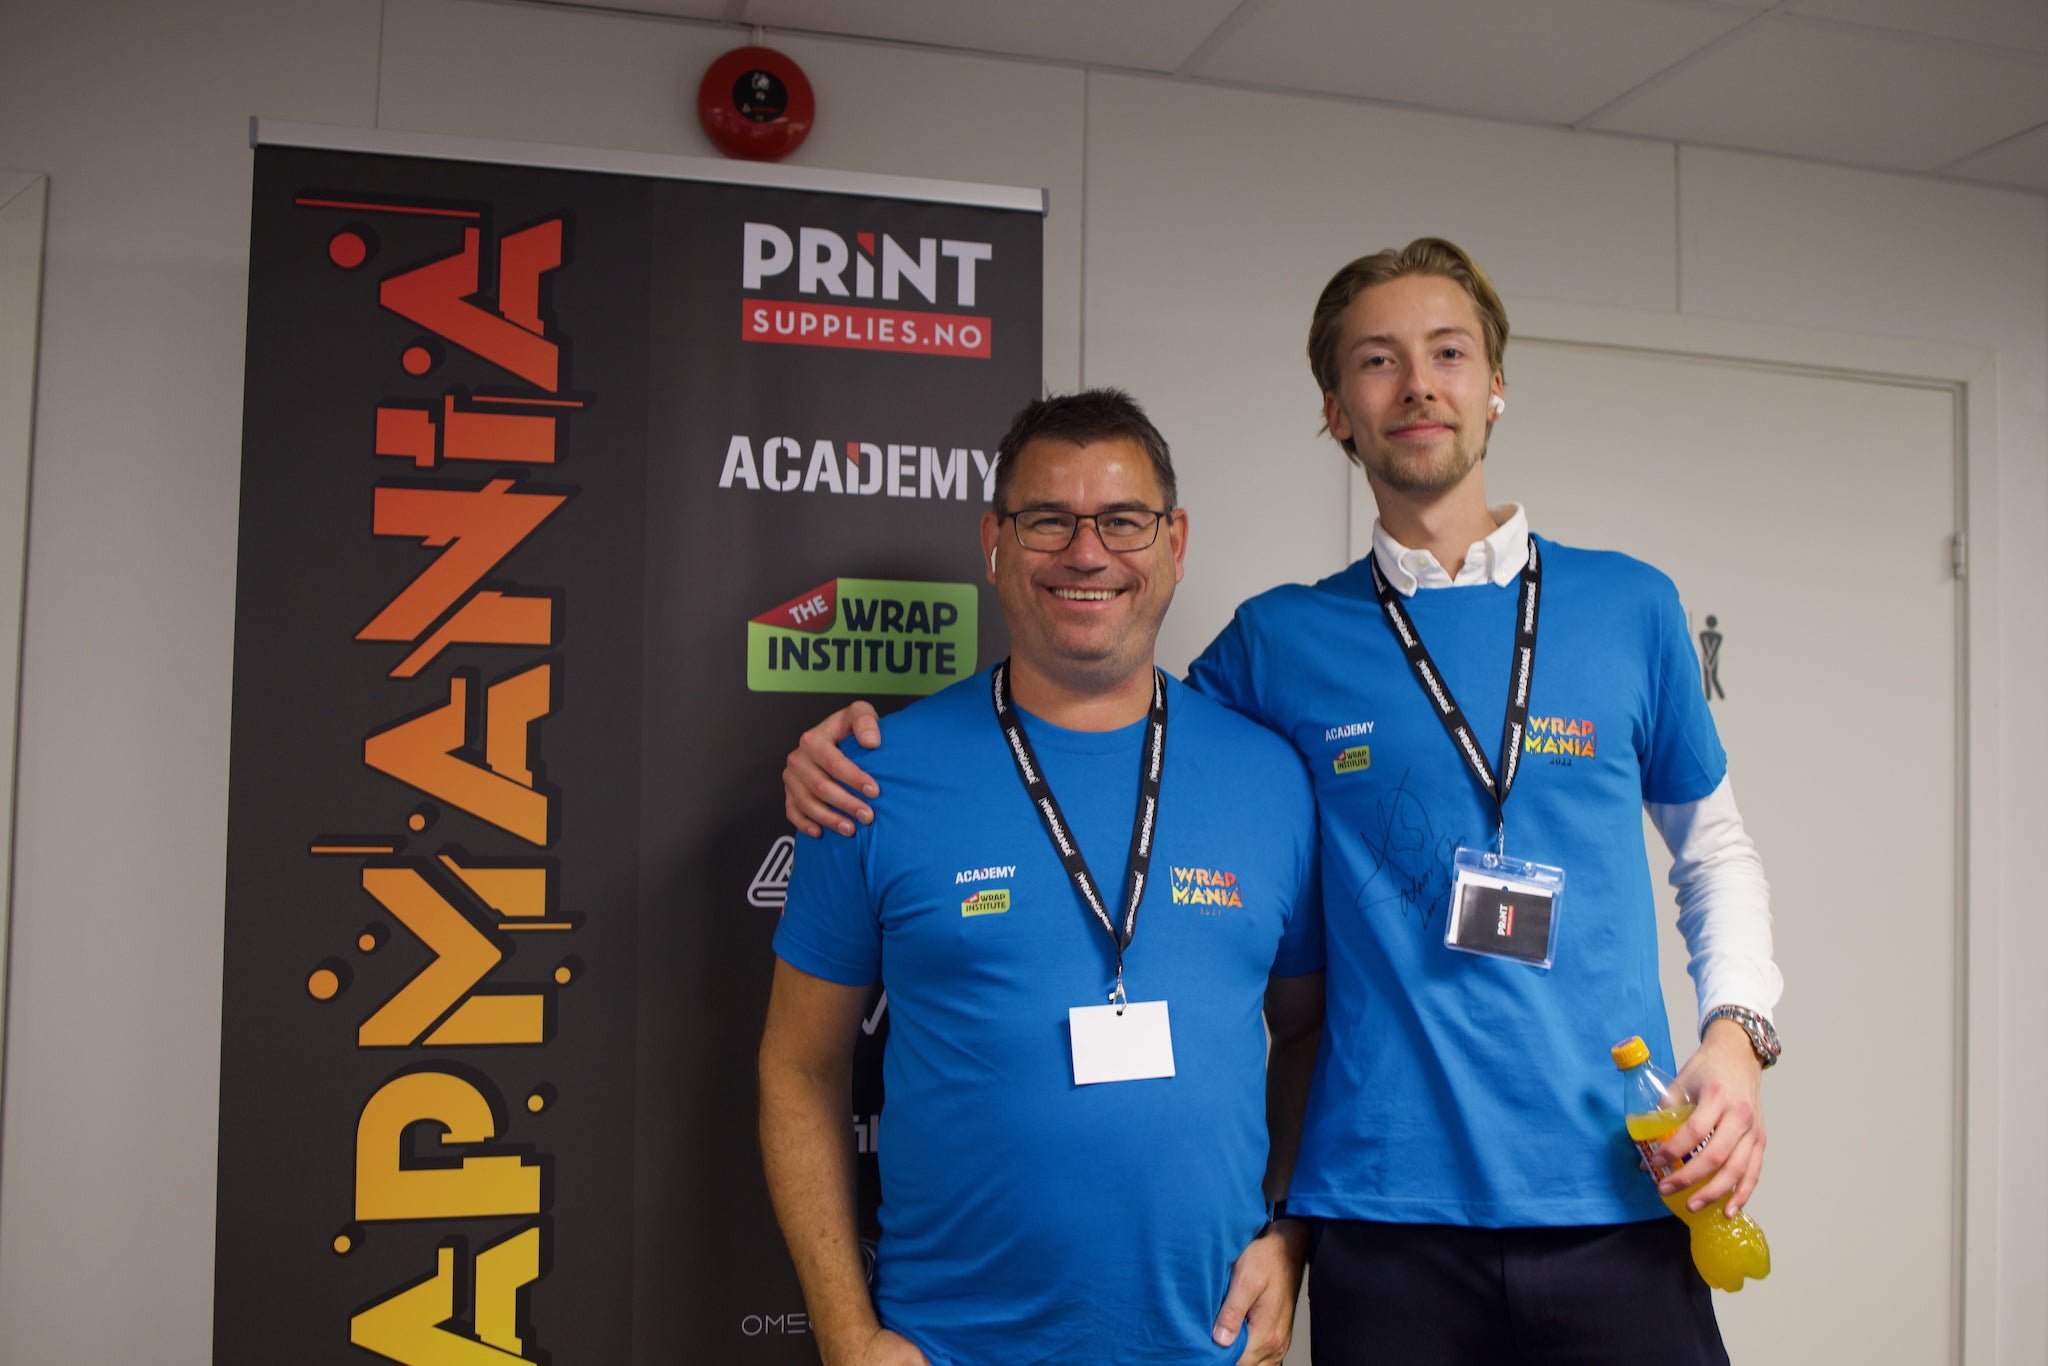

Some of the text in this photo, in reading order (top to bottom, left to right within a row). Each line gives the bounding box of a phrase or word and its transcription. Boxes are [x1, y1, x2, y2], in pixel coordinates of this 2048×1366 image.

[752, 309, 983, 349] SUPPLIES.NO
[718, 435, 1001, 502] ACADEMY
[788, 594, 959, 635] THE WRAP
[768, 636, 957, 675] INSTITUTE
[1325, 721, 1375, 742] ACADEMY
[1529, 716, 1594, 737] WRAP
[1525, 735, 1596, 758] MANIA
[955, 865, 1016, 885] ACADEMY
[1174, 867, 1236, 888] WRAP
[965, 901, 1007, 913] INSTITUTE
[980, 893, 1006, 902] WRAP
[1172, 886, 1243, 908] MANIA
[741, 1313, 813, 1336] OME
